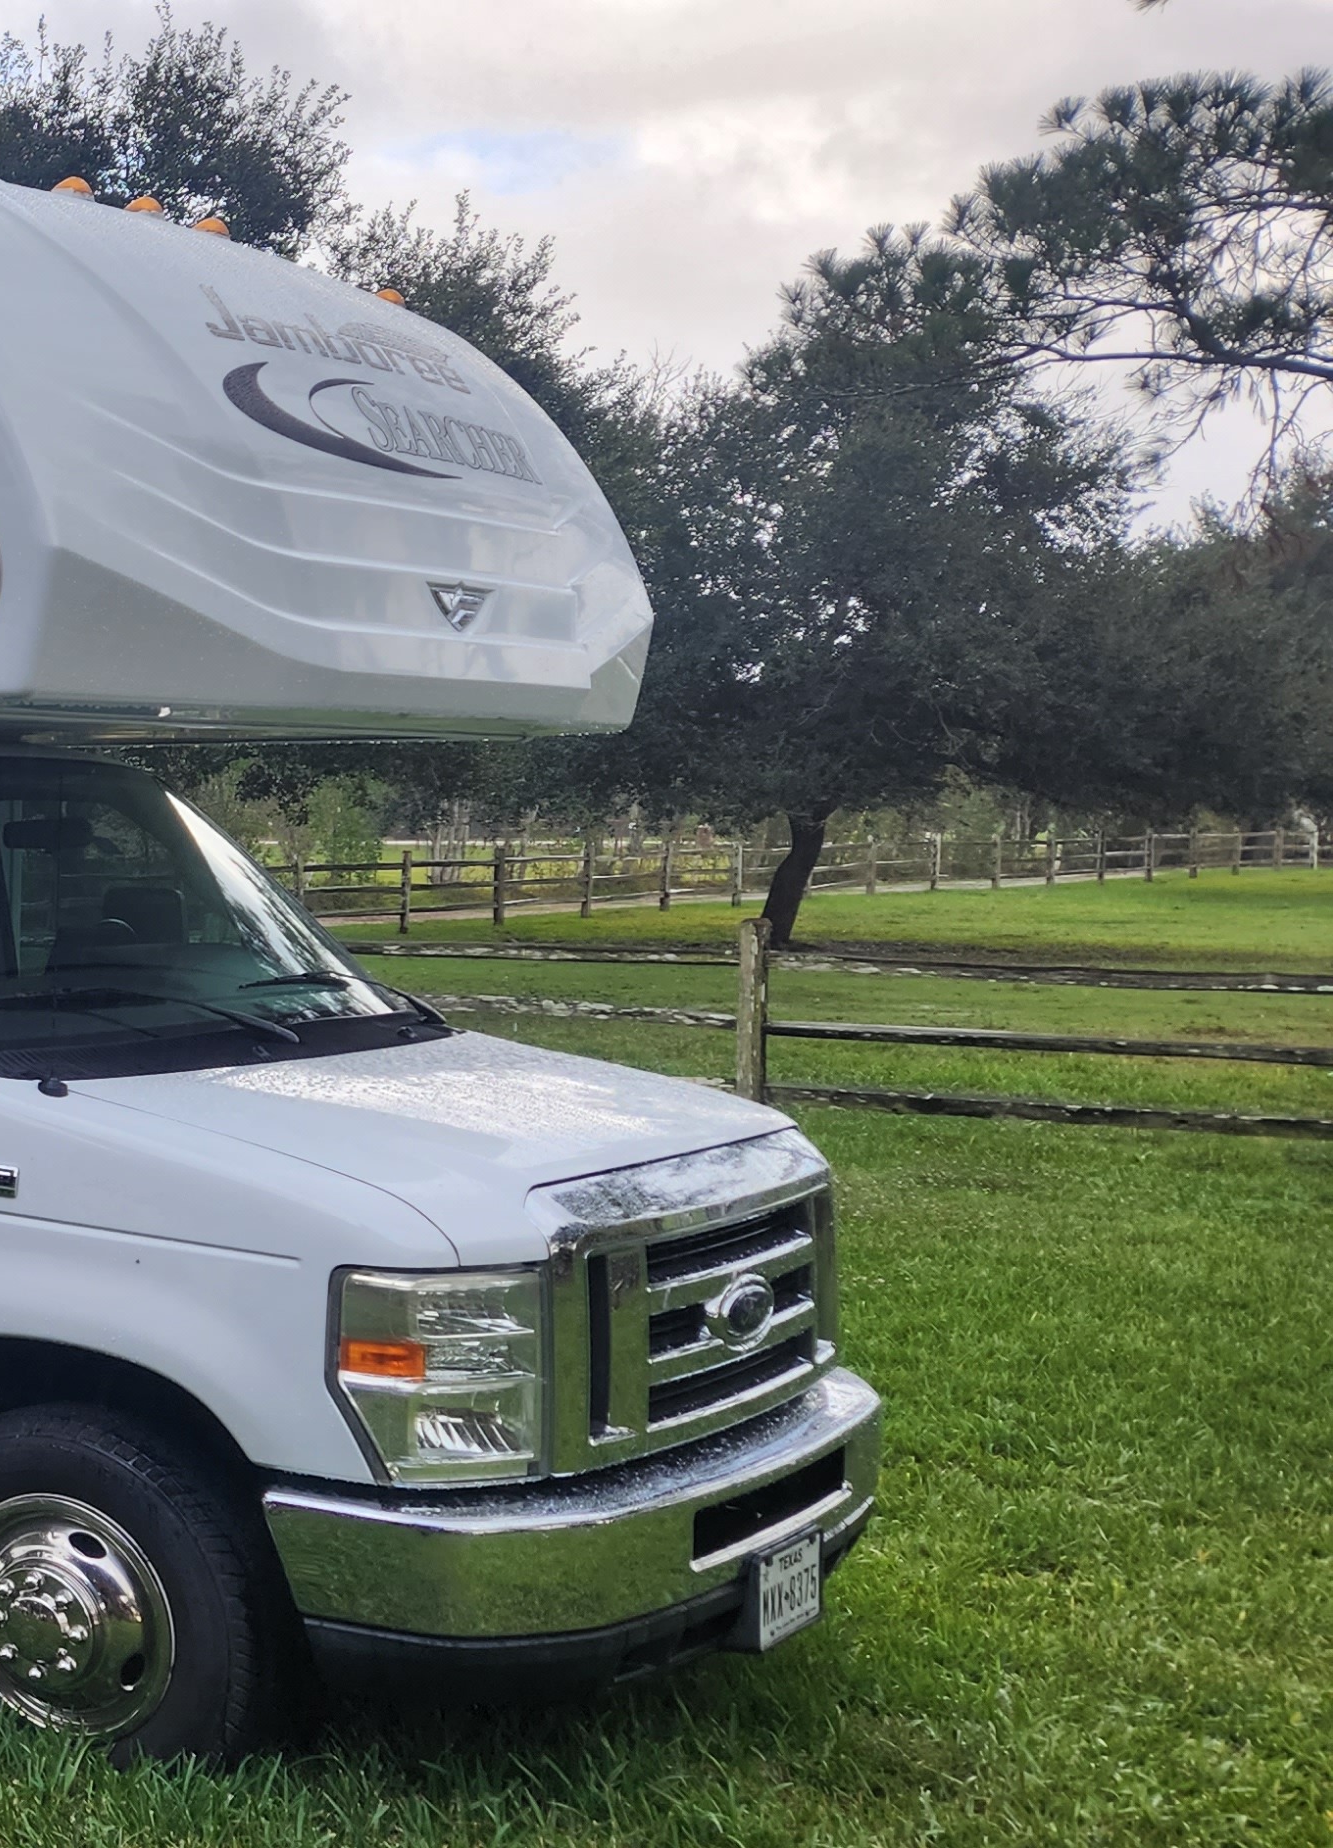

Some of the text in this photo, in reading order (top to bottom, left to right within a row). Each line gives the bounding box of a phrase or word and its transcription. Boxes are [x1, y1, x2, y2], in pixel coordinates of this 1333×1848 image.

[199, 284, 471, 394] Jamboree
[351, 386, 542, 485] SEARCHER
[779, 1548, 803, 1572] TEXAS
